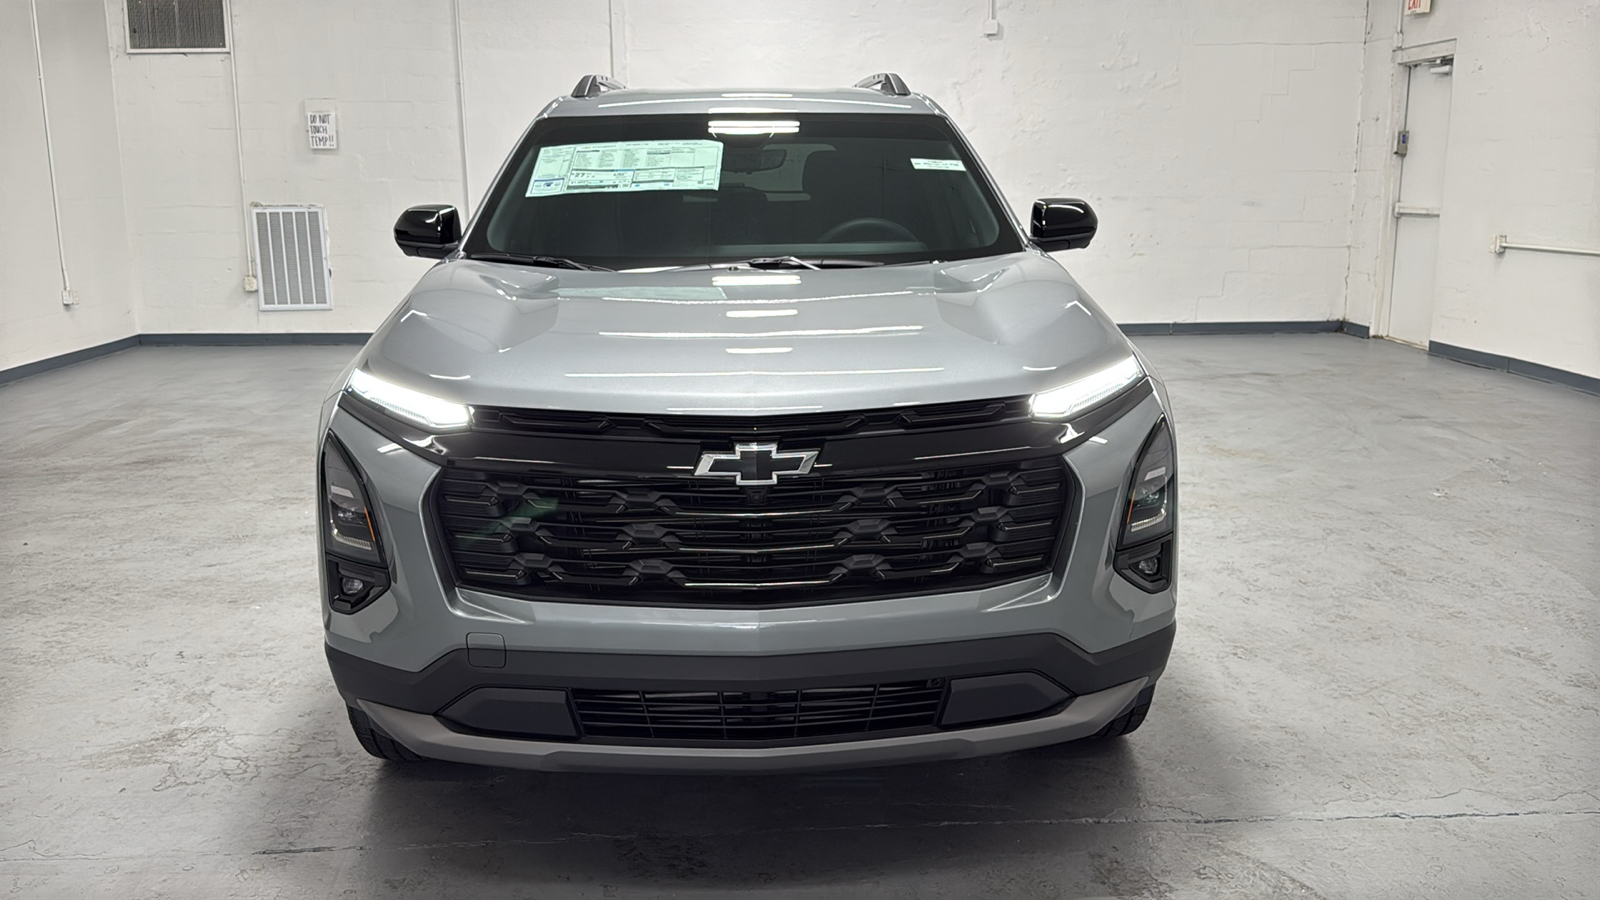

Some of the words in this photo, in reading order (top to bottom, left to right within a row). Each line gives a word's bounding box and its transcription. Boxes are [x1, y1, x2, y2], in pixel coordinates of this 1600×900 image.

[310, 114, 317, 124] DO
[319, 114, 331, 124] NOT
[310, 125, 327, 134] TOUCH
[311, 135, 334, 147] TEMP!!
